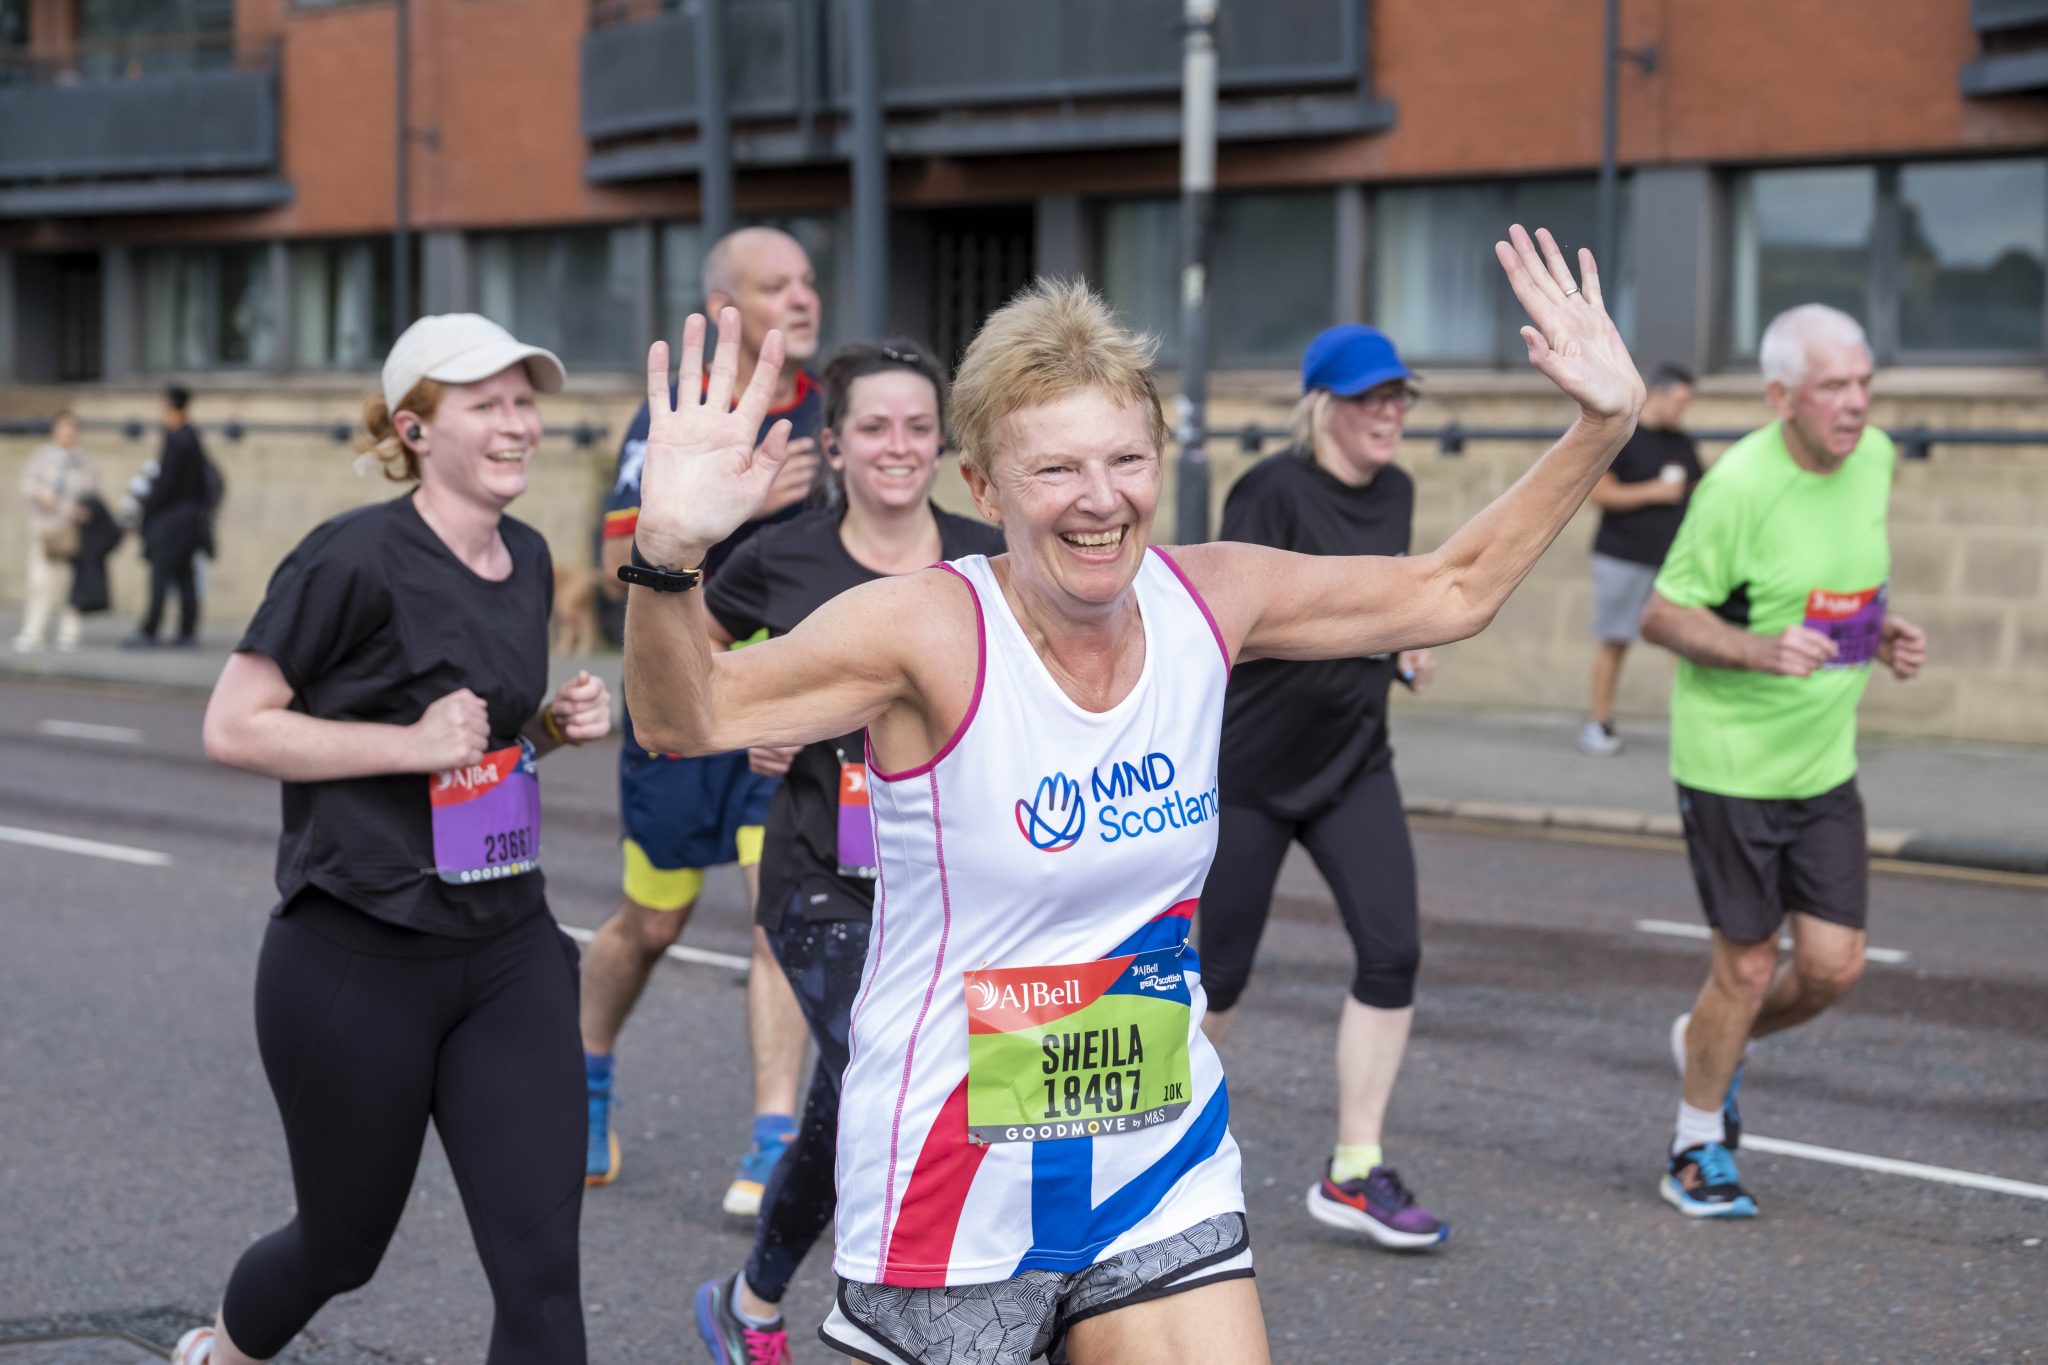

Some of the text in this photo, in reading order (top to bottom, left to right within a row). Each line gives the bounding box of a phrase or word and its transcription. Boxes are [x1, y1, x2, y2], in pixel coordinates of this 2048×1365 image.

[1092, 752, 1175, 803] MND
[1099, 776, 1219, 843] Scotland
[1042, 1024, 1143, 1075] SHEILA
[1043, 1069, 1141, 1118] 18497
[1163, 1083, 1183, 1102] 10K
[1005, 1109, 1165, 1140] GOODMOVE by M&S
